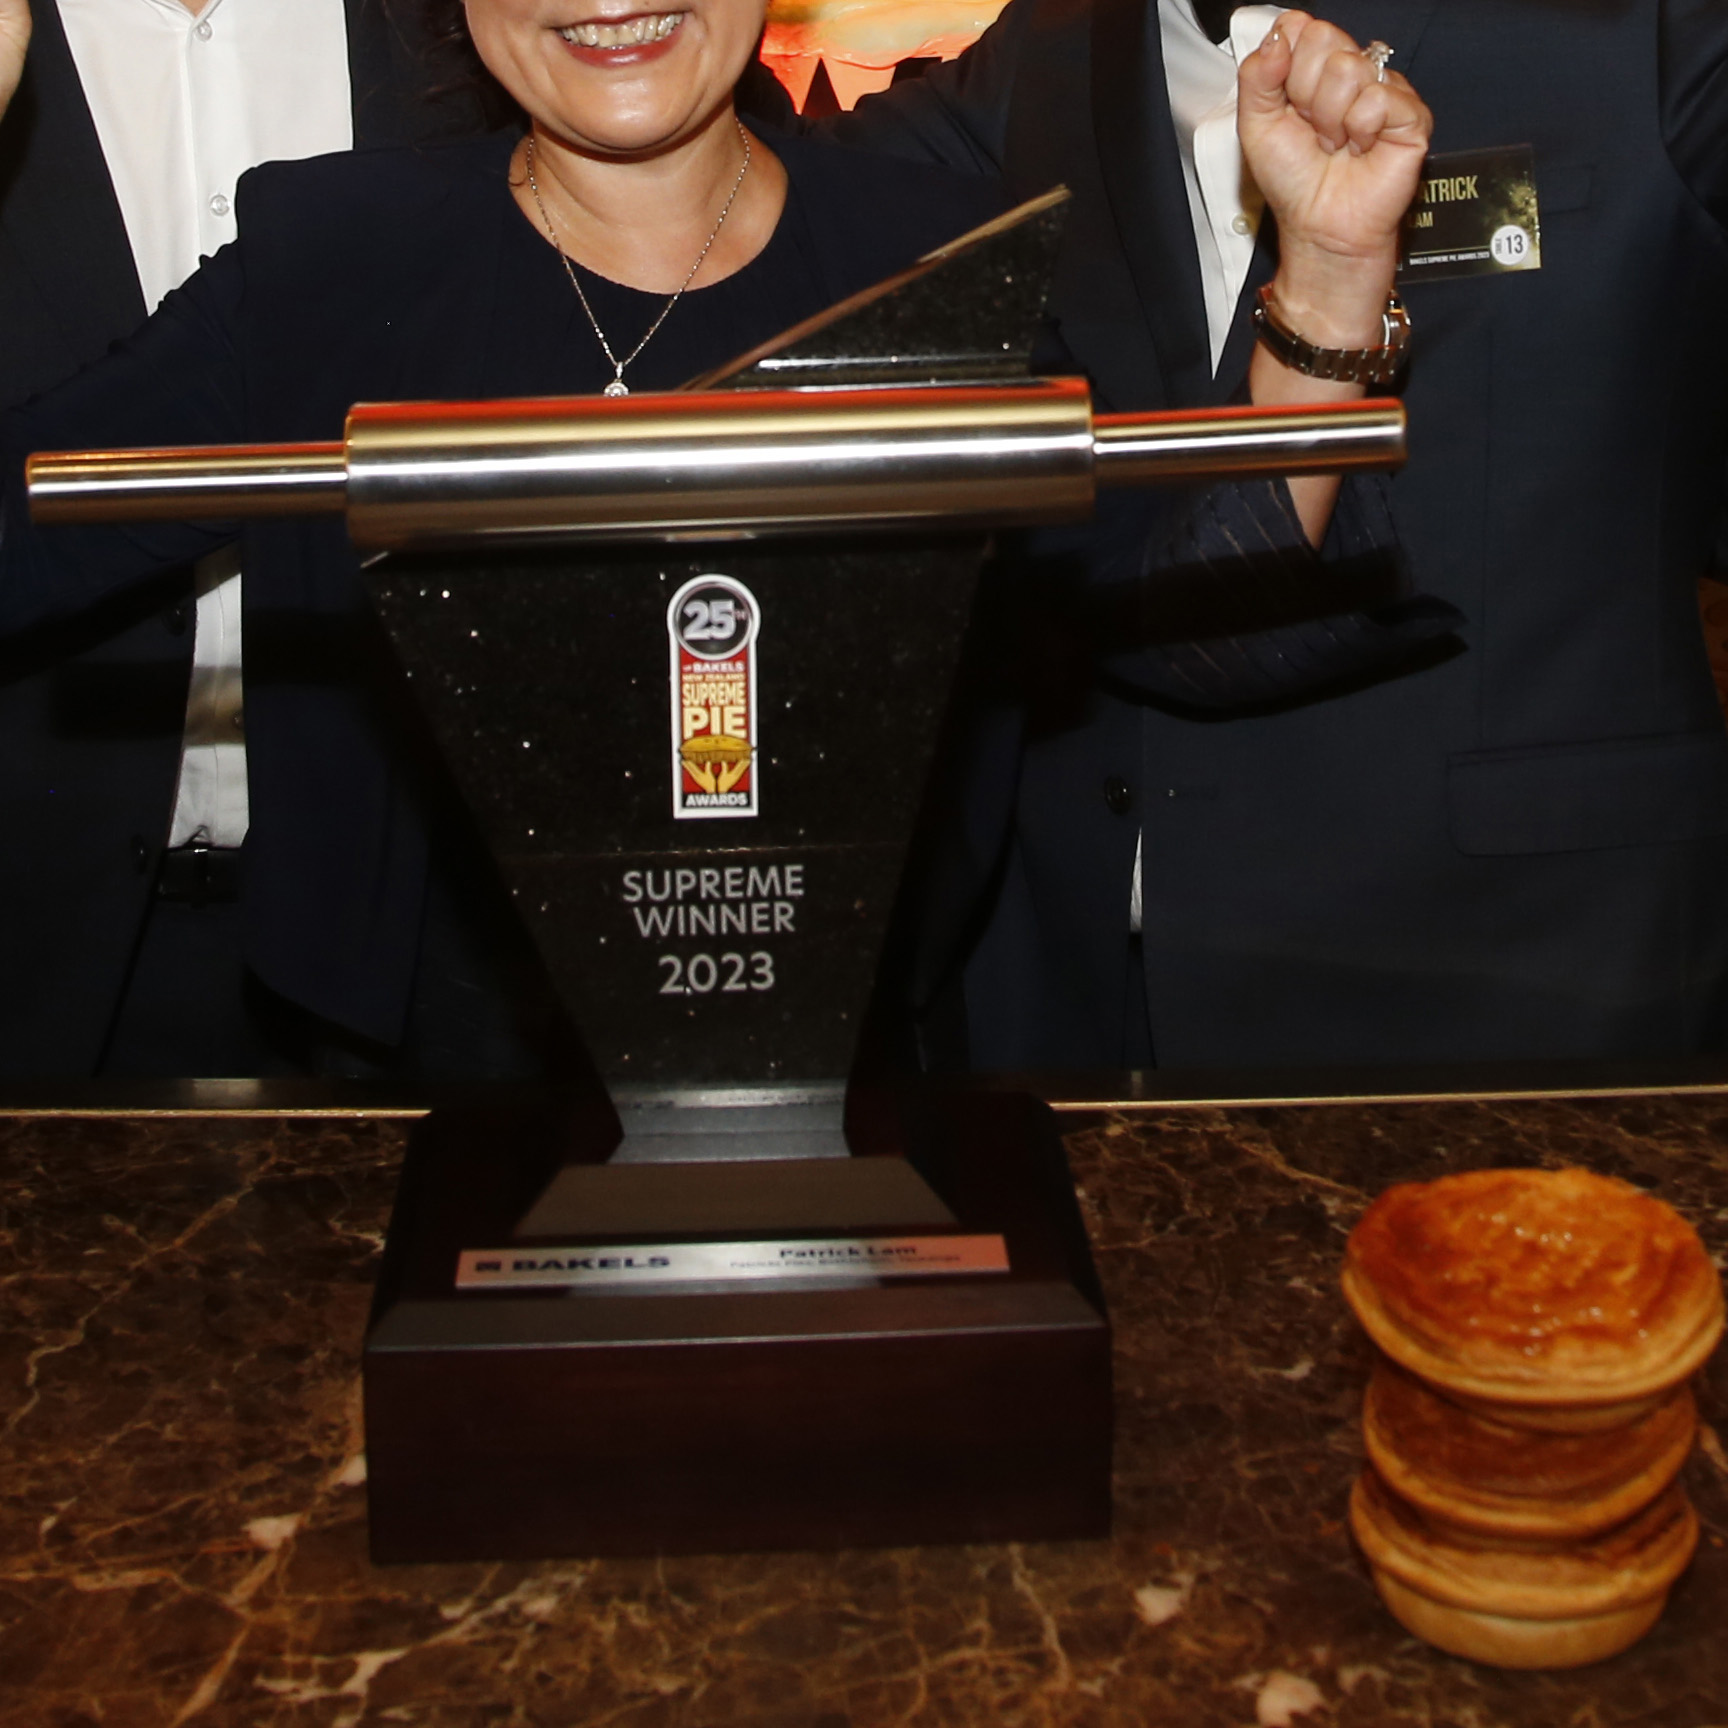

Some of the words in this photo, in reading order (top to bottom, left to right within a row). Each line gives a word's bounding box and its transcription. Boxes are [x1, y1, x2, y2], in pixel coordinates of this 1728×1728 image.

[1506, 233, 1523, 254] 13
[693, 661, 744, 673] BAKELS
[682, 682, 746, 706] SUPREME
[683, 706, 747, 740] PIE
[685, 792, 748, 807] AWARDS
[622, 865, 804, 903] SUPREME
[632, 901, 795, 938] WINNER
[658, 951, 775, 994] 2023
[513, 1256, 670, 1271] BAKELS
